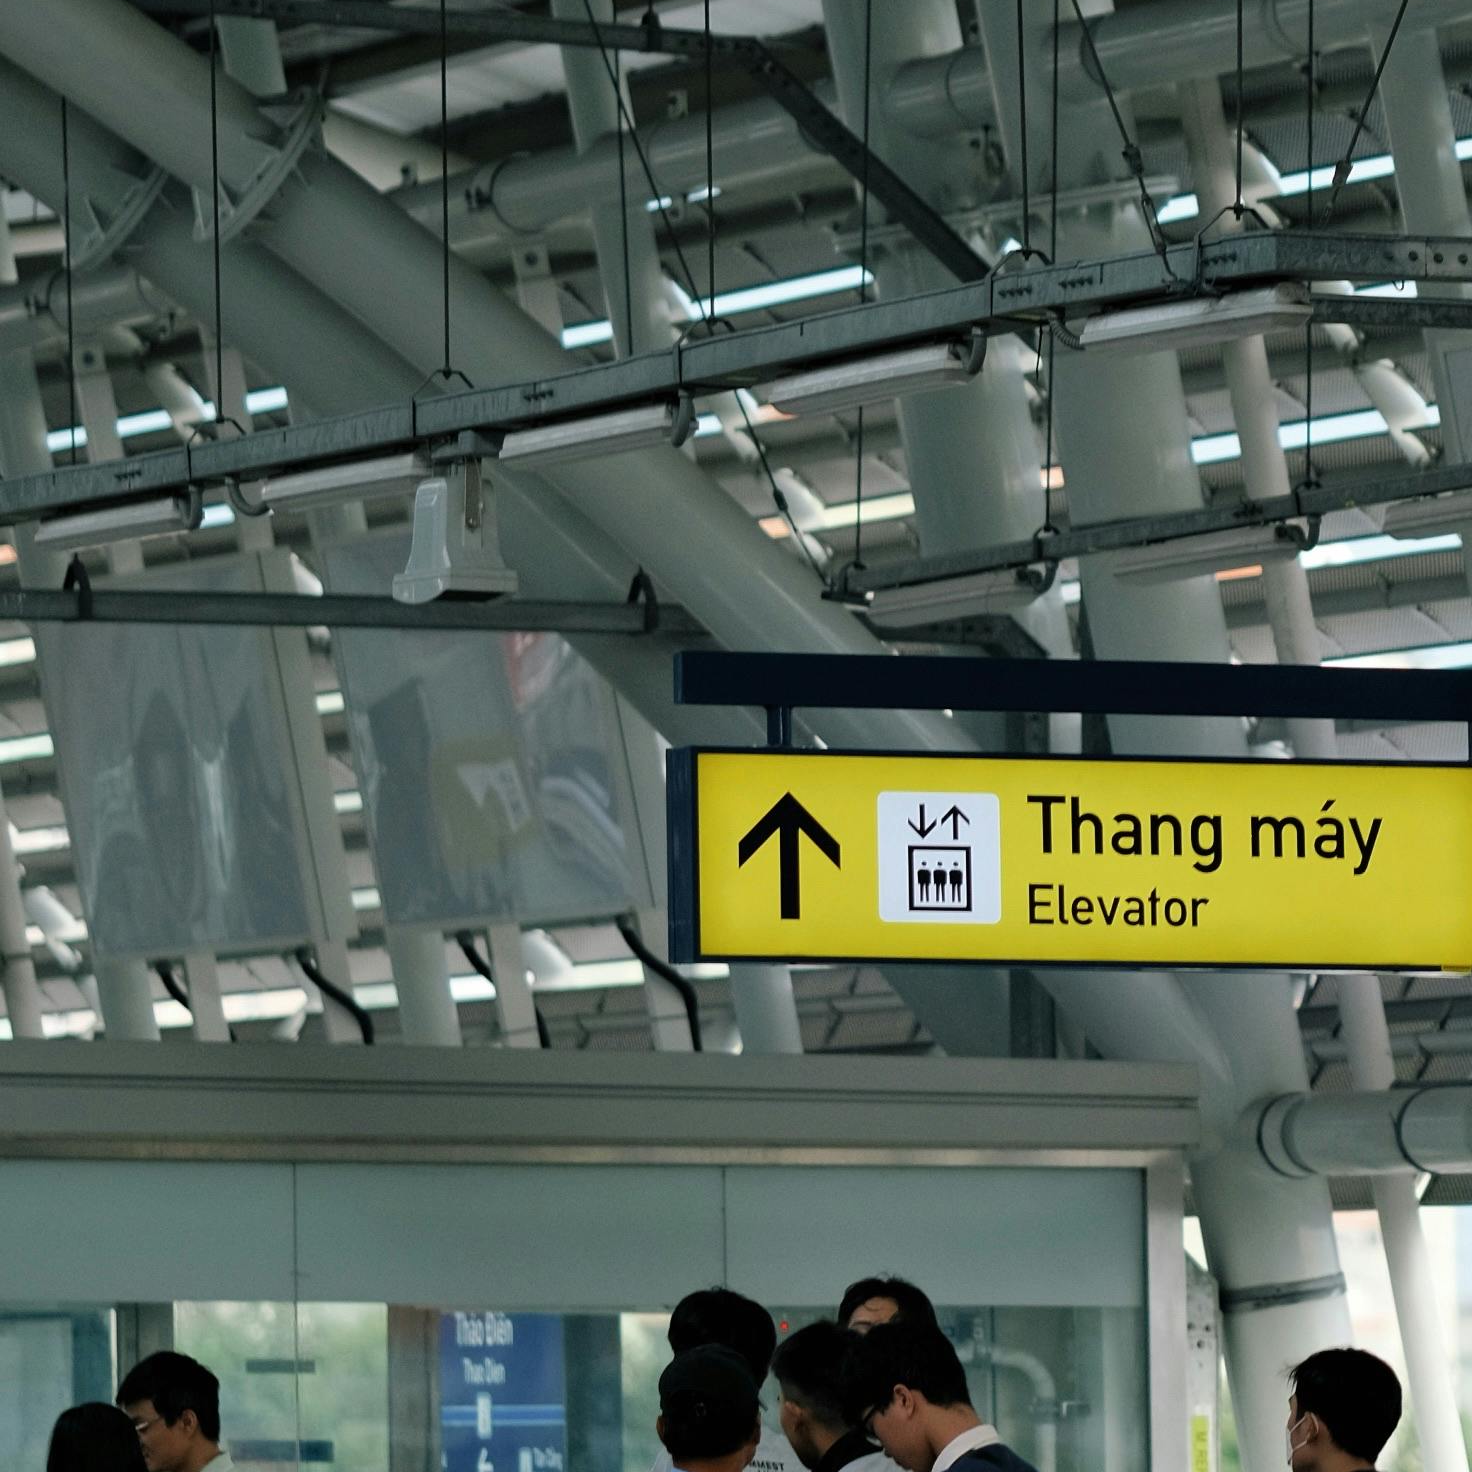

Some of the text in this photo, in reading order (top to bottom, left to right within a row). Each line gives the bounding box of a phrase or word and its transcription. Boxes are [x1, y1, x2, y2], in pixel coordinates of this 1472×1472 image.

[1027, 795, 1383, 876] Thang máy
[1028, 883, 1209, 927] Elevator
